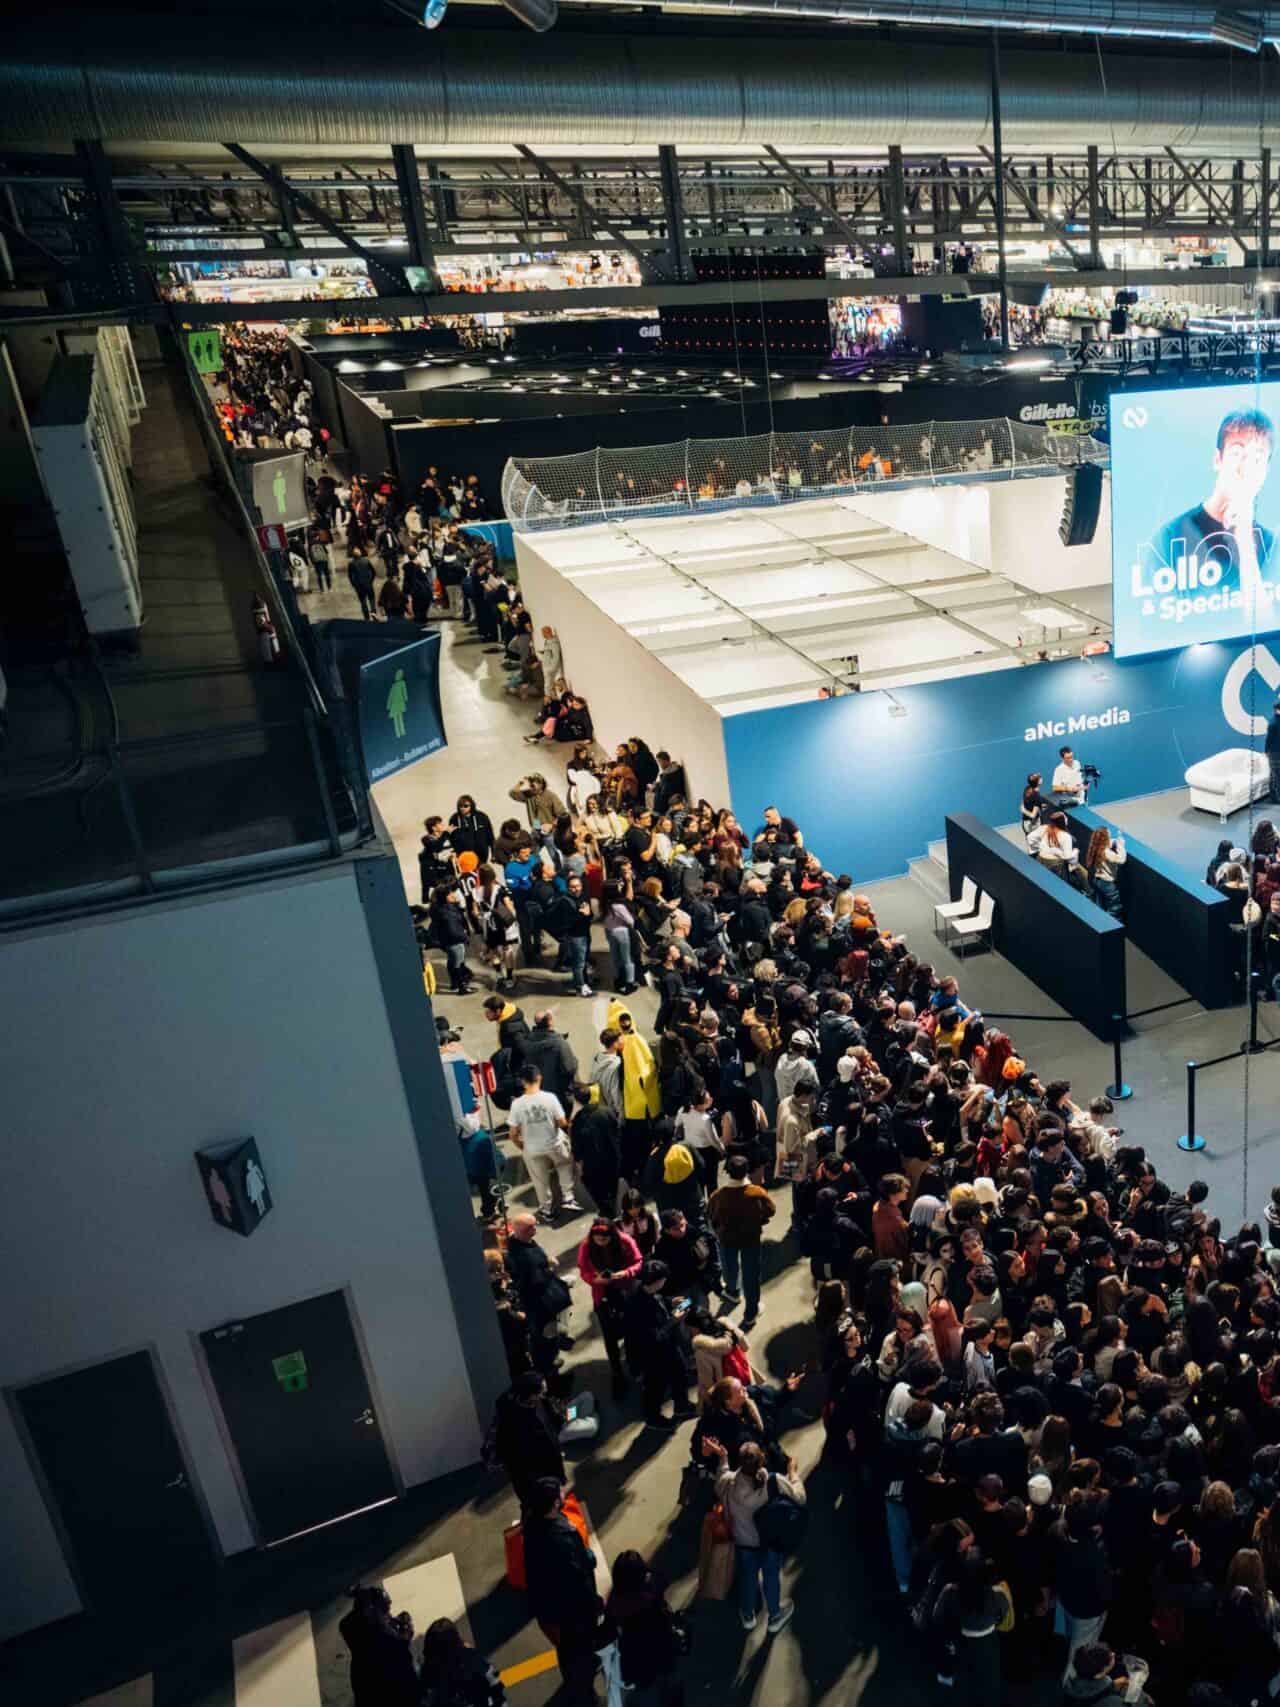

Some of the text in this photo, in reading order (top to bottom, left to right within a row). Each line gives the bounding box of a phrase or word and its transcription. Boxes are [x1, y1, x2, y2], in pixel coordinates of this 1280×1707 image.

[639, 325, 660, 337] Gill
[1020, 403, 1076, 420] Gillette
[1132, 555, 1223, 597] Lollo
[1024, 706, 1131, 742] aNc Media
